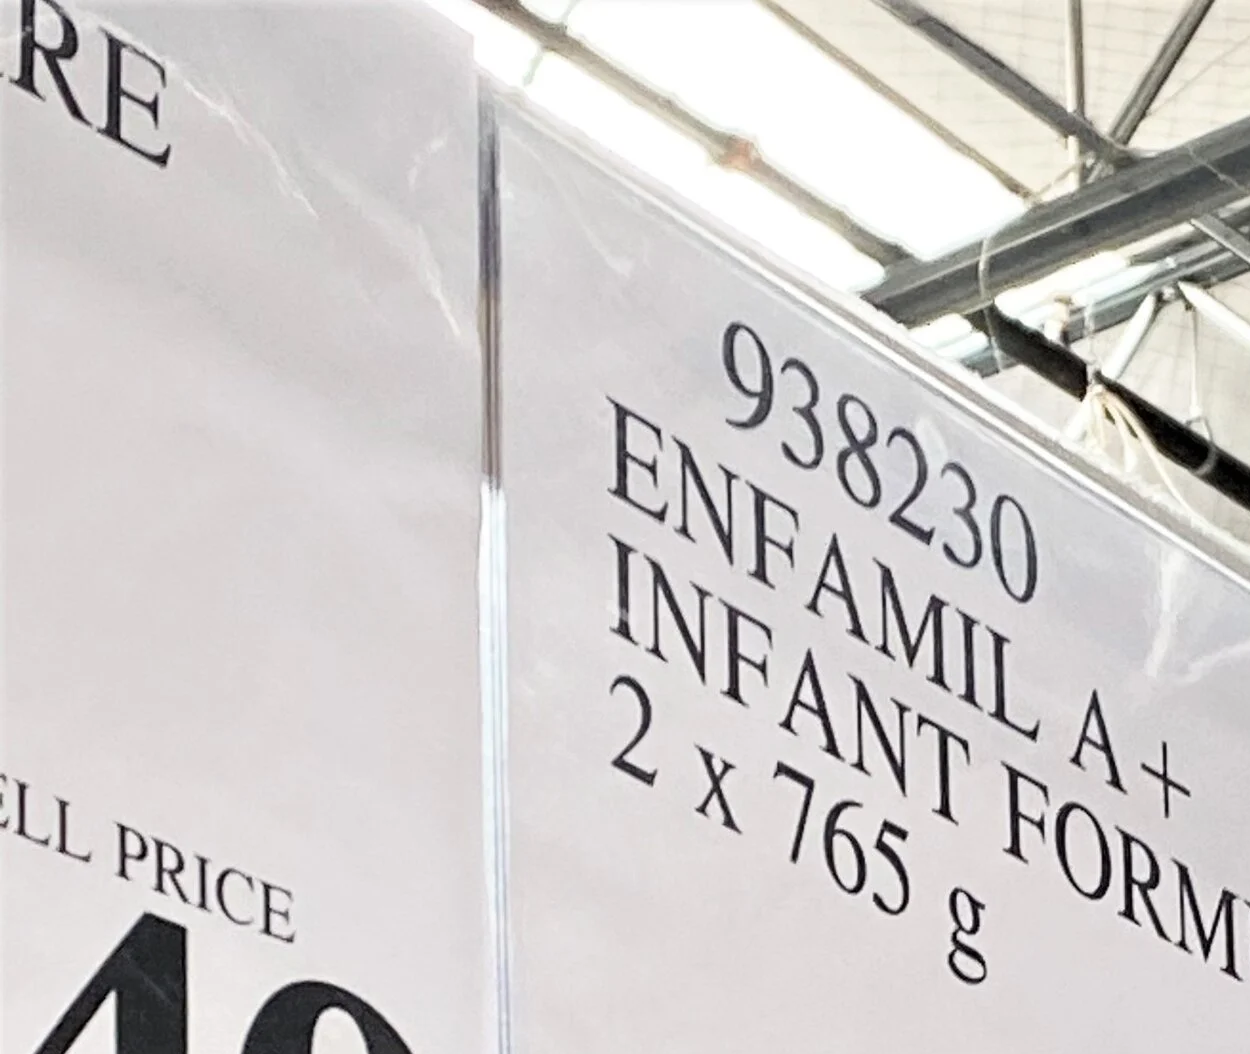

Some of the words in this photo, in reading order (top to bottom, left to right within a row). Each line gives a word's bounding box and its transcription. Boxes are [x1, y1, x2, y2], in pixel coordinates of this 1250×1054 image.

[0, 0, 172, 169] RE
[721, 321, 1038, 604] 938230
[605, 395, 1040, 742] ENFAMIL
[1070, 688, 1192, 819] A+
[608, 533, 970, 825] INFANT
[113, 822, 296, 944] PRICE
[609, 674, 658, 787] 2
[695, 744, 742, 834] x
[773, 762, 911, 916] 765
[947, 887, 988, 984] g
